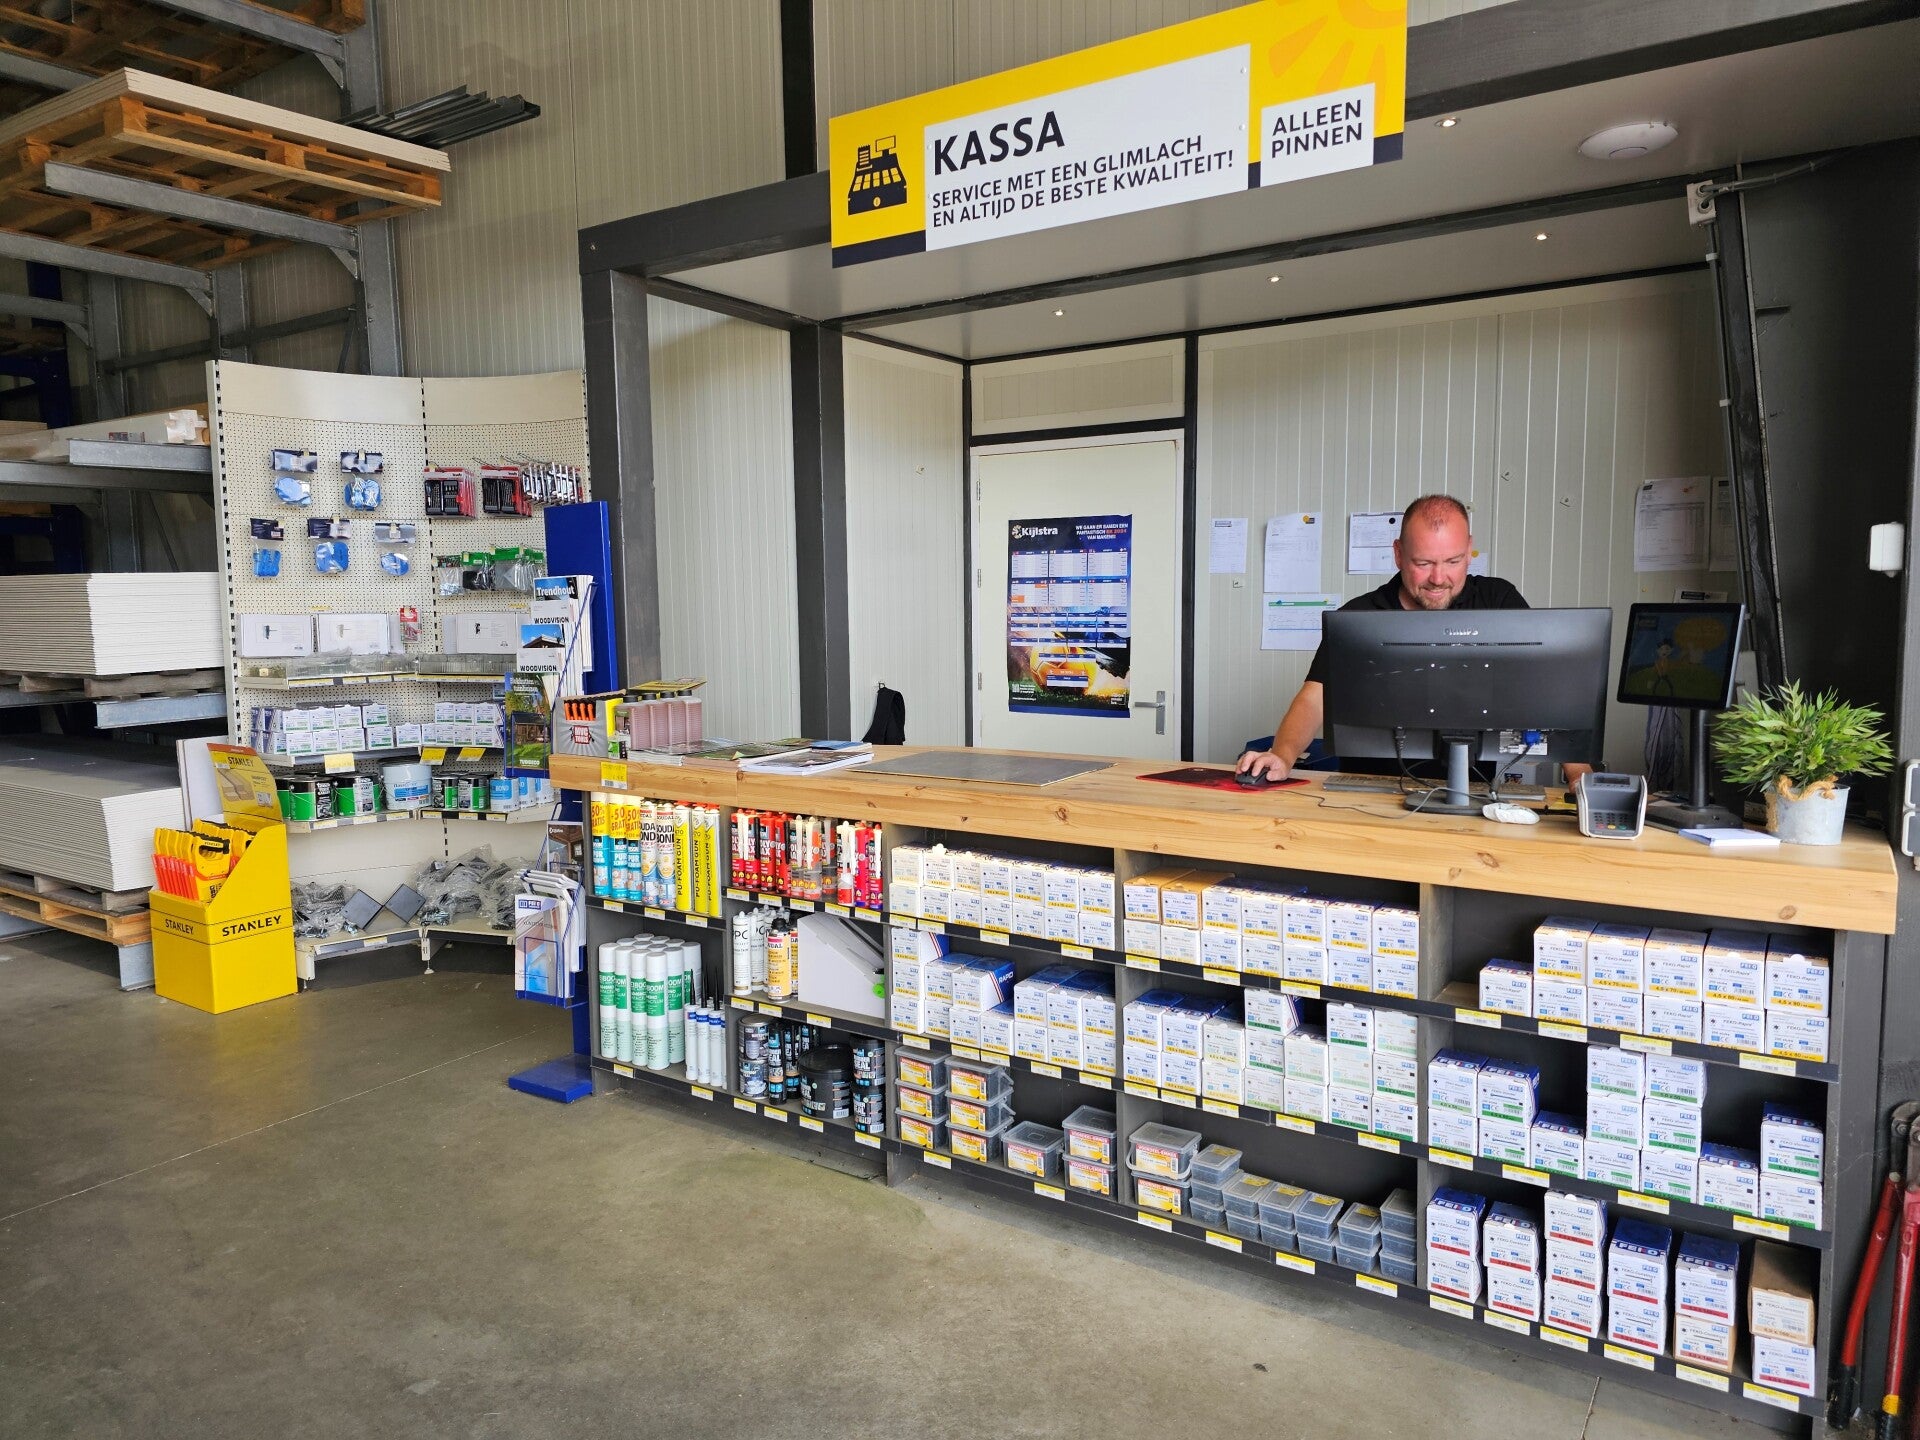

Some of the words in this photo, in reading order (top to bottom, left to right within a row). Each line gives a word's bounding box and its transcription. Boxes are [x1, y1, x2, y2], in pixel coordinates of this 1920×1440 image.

[1272, 99, 1362, 137] ALLEEN
[935, 111, 1065, 175] KASSA
[1271, 123, 1363, 160] PINNEN
[933, 180, 1001, 208] SERVICE
[1008, 170, 1045, 193] MET
[1052, 161, 1087, 183] EEN
[1094, 135, 1201, 174] GLIMLACH
[933, 209, 954, 227] EN
[960, 198, 1015, 222] ALTIJD
[1022, 190, 1045, 210] DE
[1051, 177, 1107, 204] BESTE
[1114, 150, 1233, 191] KWALITEIT!
[1022, 526, 1058, 538] Kijlstra
[536, 585, 575, 597] Trendhout
[534, 616, 569, 624] WOODVISION
[228, 756, 254, 767] STANLEY
[165, 918, 194, 935] STANLEY
[222, 915, 281, 937] STANLEY
